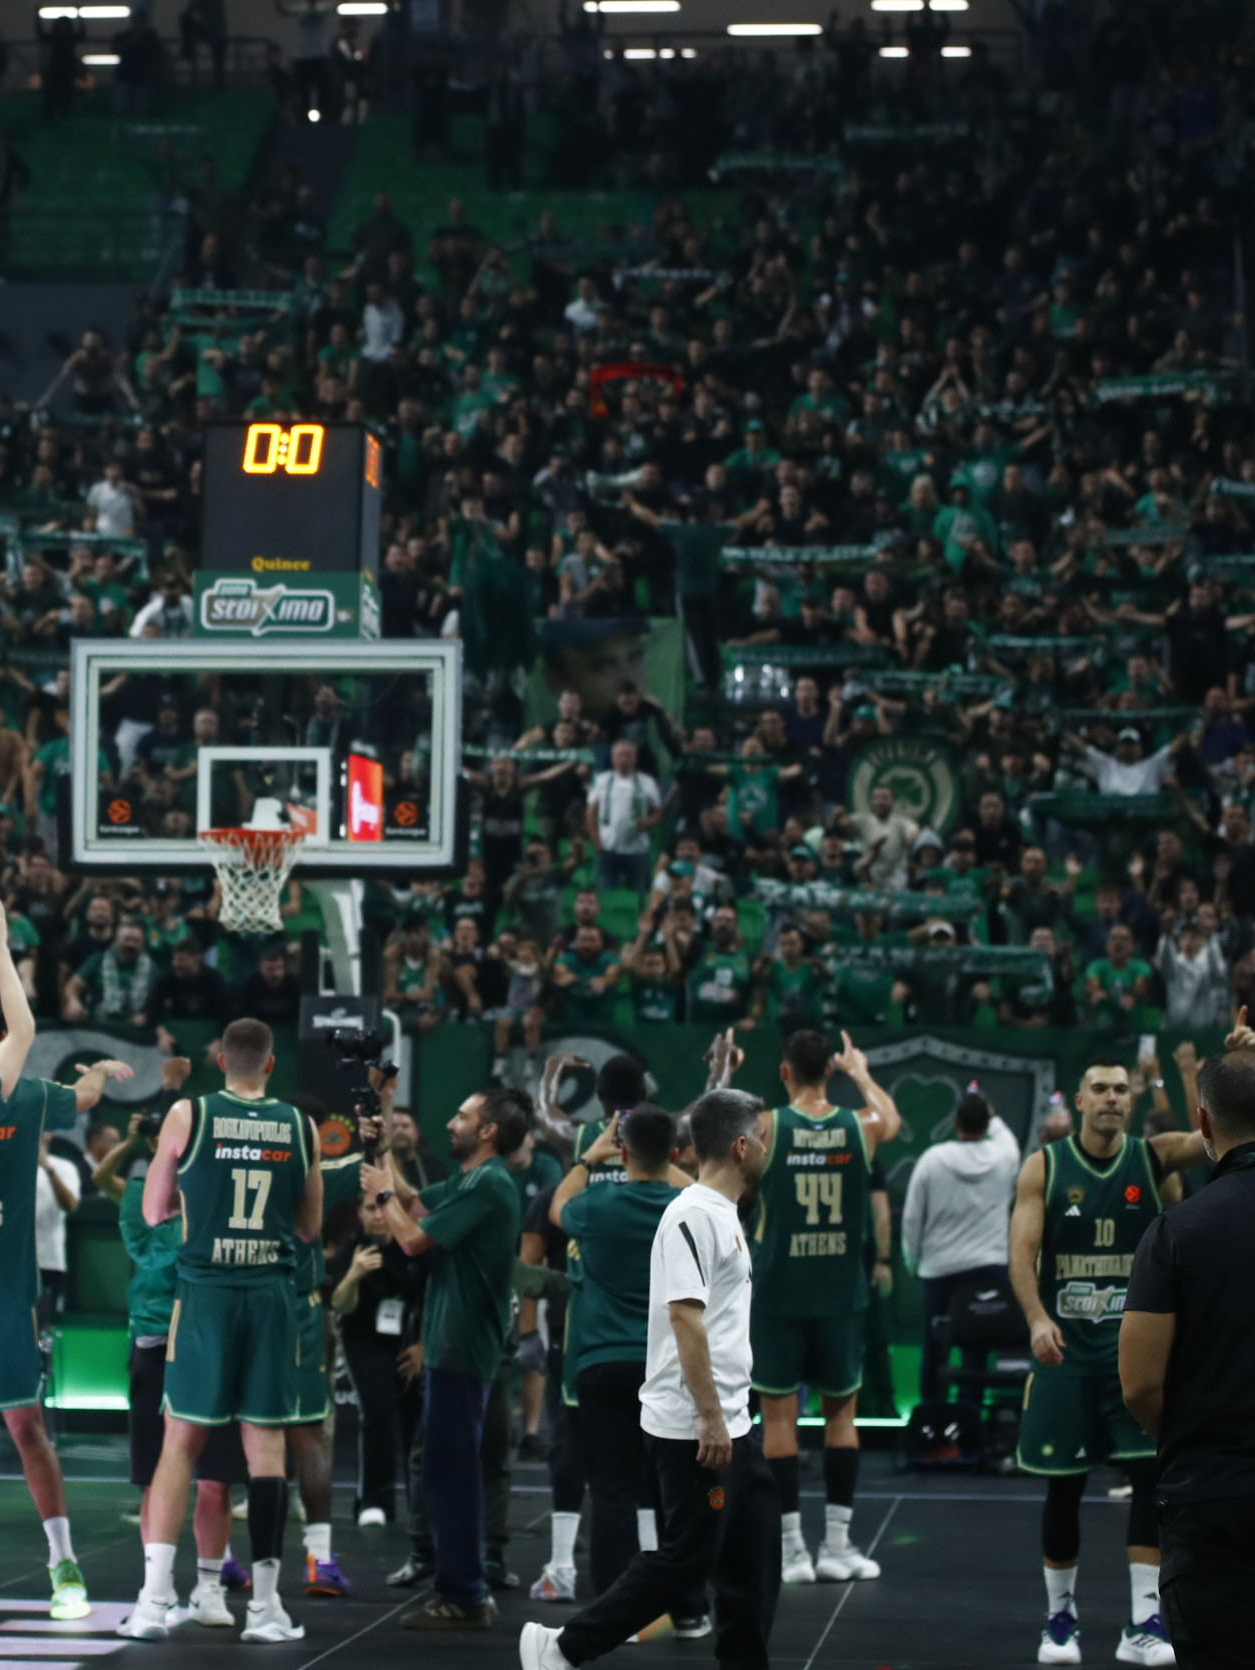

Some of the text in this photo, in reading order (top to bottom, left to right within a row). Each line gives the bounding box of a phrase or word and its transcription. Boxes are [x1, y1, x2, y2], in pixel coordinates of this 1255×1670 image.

[251, 556, 311, 572] Quince
[214, 1143, 292, 1163] instacar
[228, 1168, 273, 1230] 17
[794, 1172, 843, 1225] 44
[789, 1231, 847, 1257] ATHENS
[1093, 1217, 1116, 1247] 10
